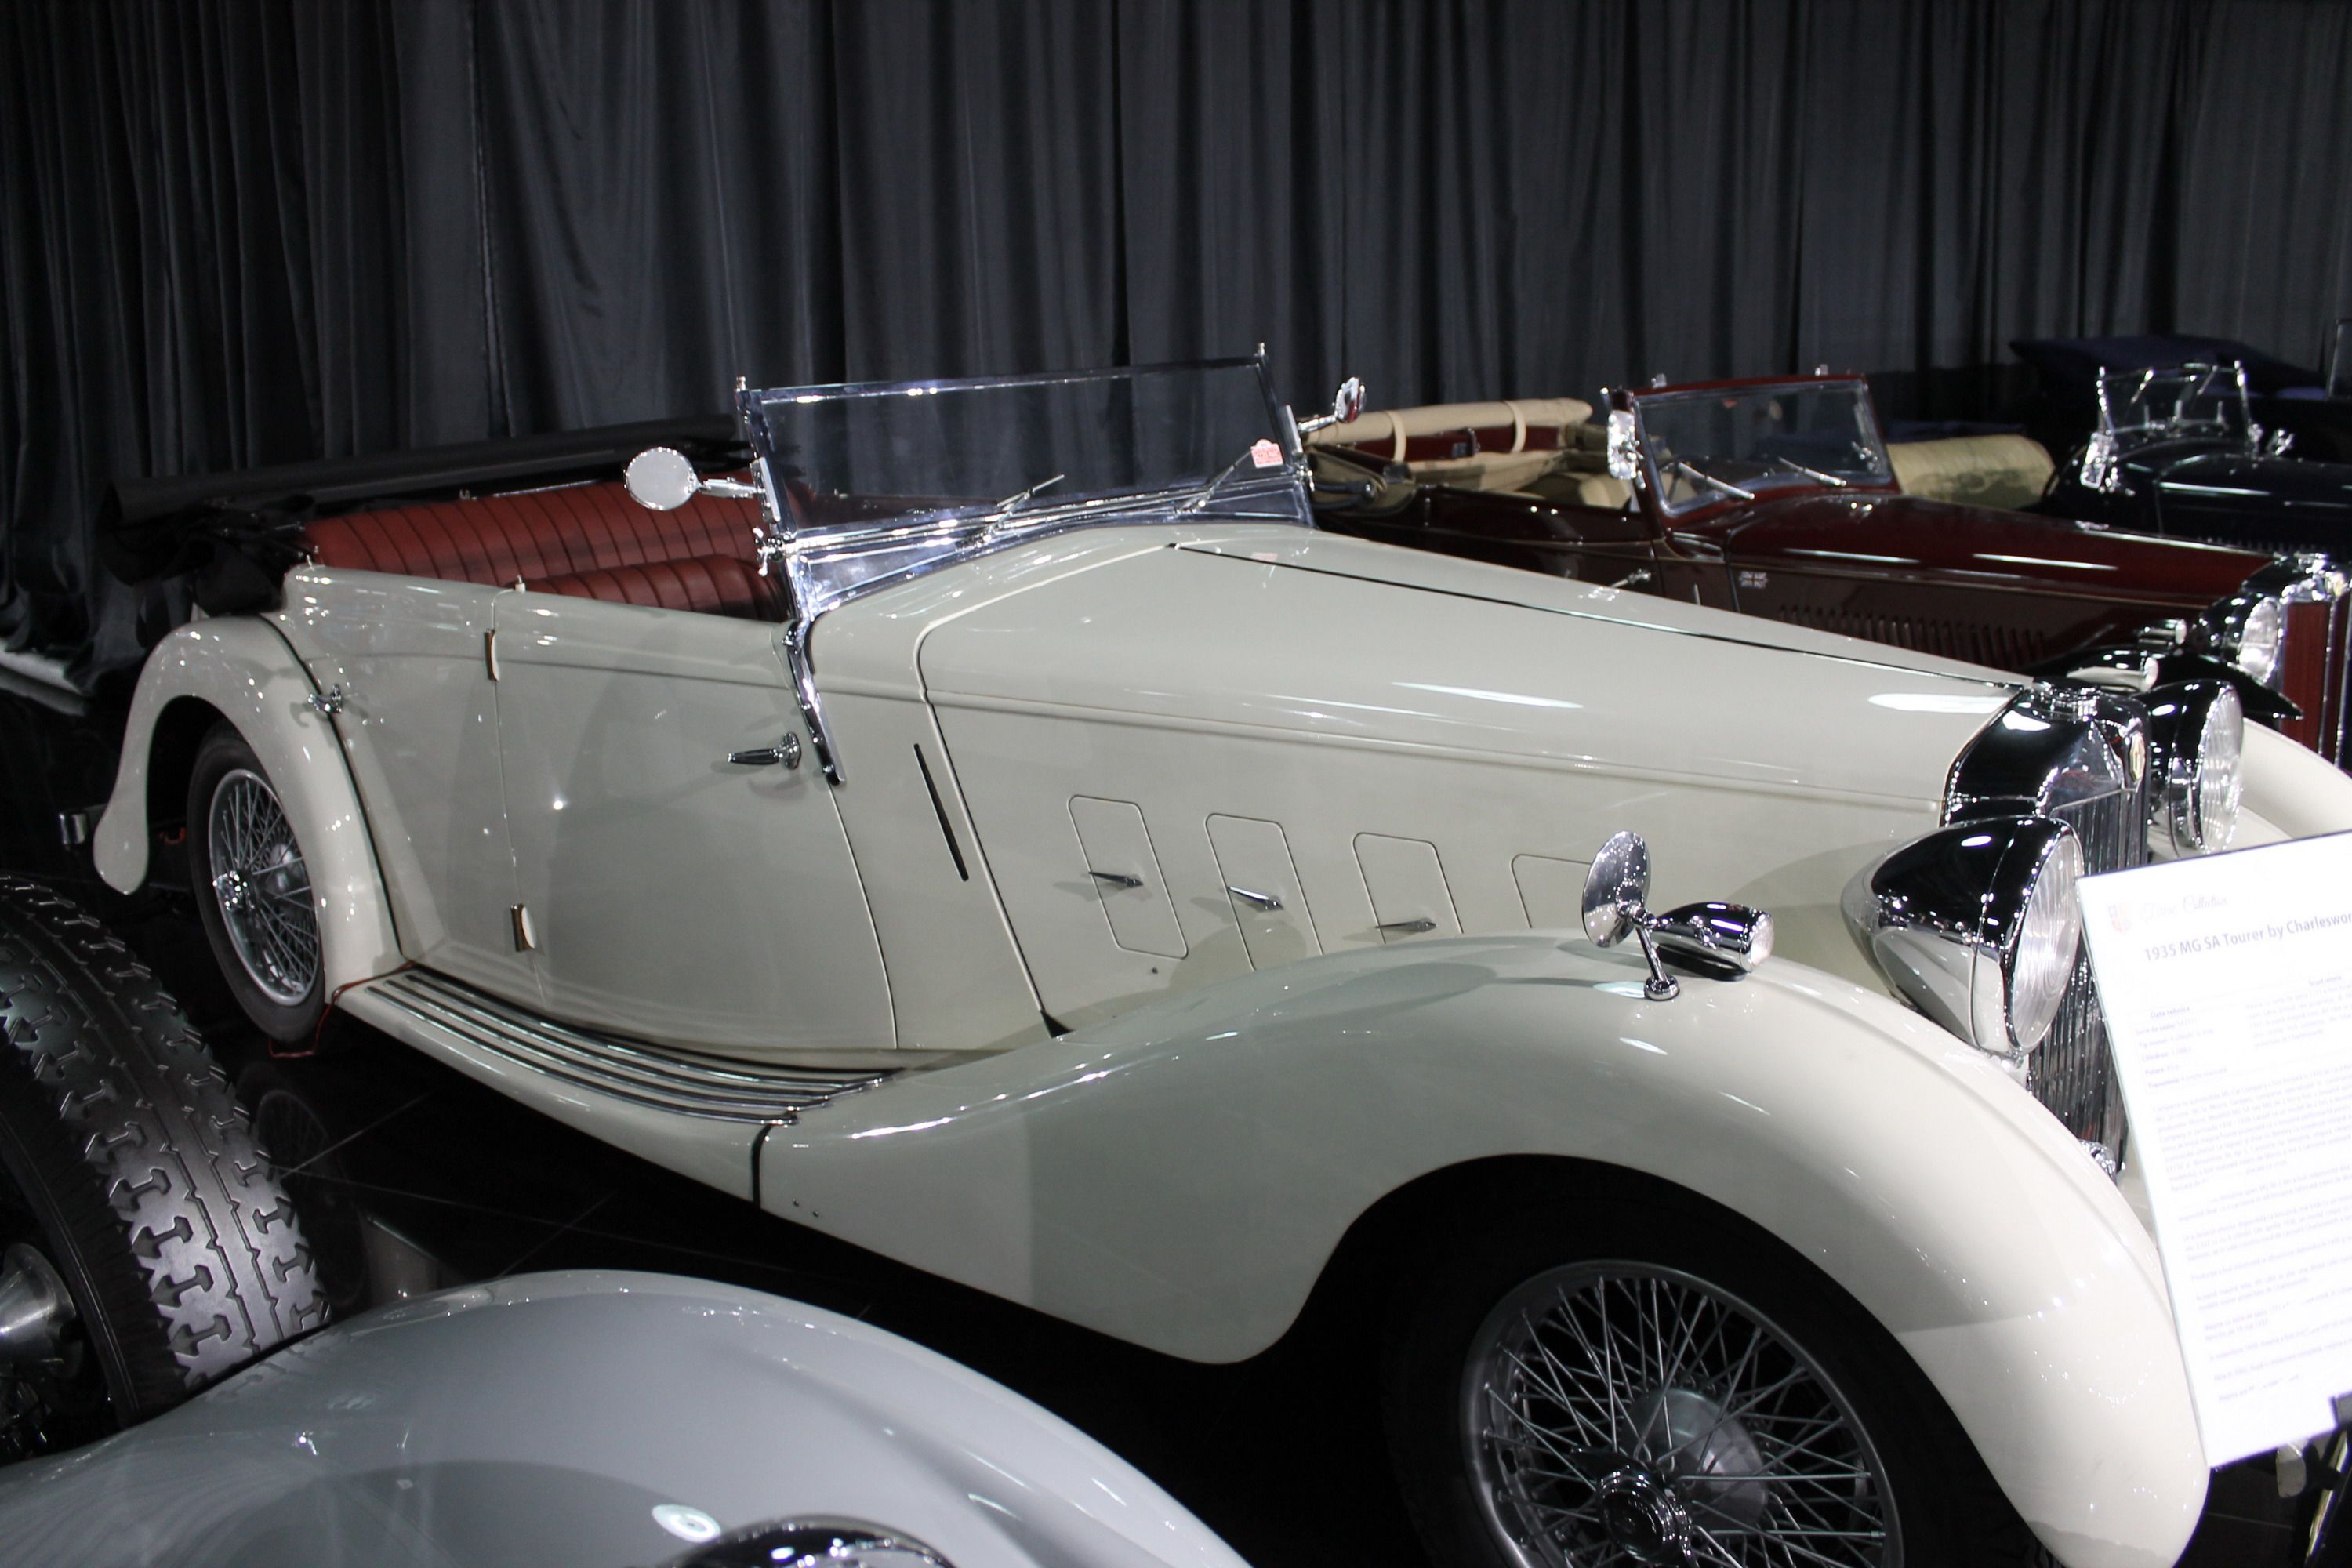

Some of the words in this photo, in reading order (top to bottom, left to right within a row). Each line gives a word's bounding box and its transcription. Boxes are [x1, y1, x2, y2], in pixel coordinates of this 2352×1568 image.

[2144, 942, 2176, 960] 1935
[2180, 937, 2202, 955] MG
[2204, 935, 2221, 950] SA
[2223, 929, 2265, 946] Tourer
[2267, 924, 2285, 940] by
